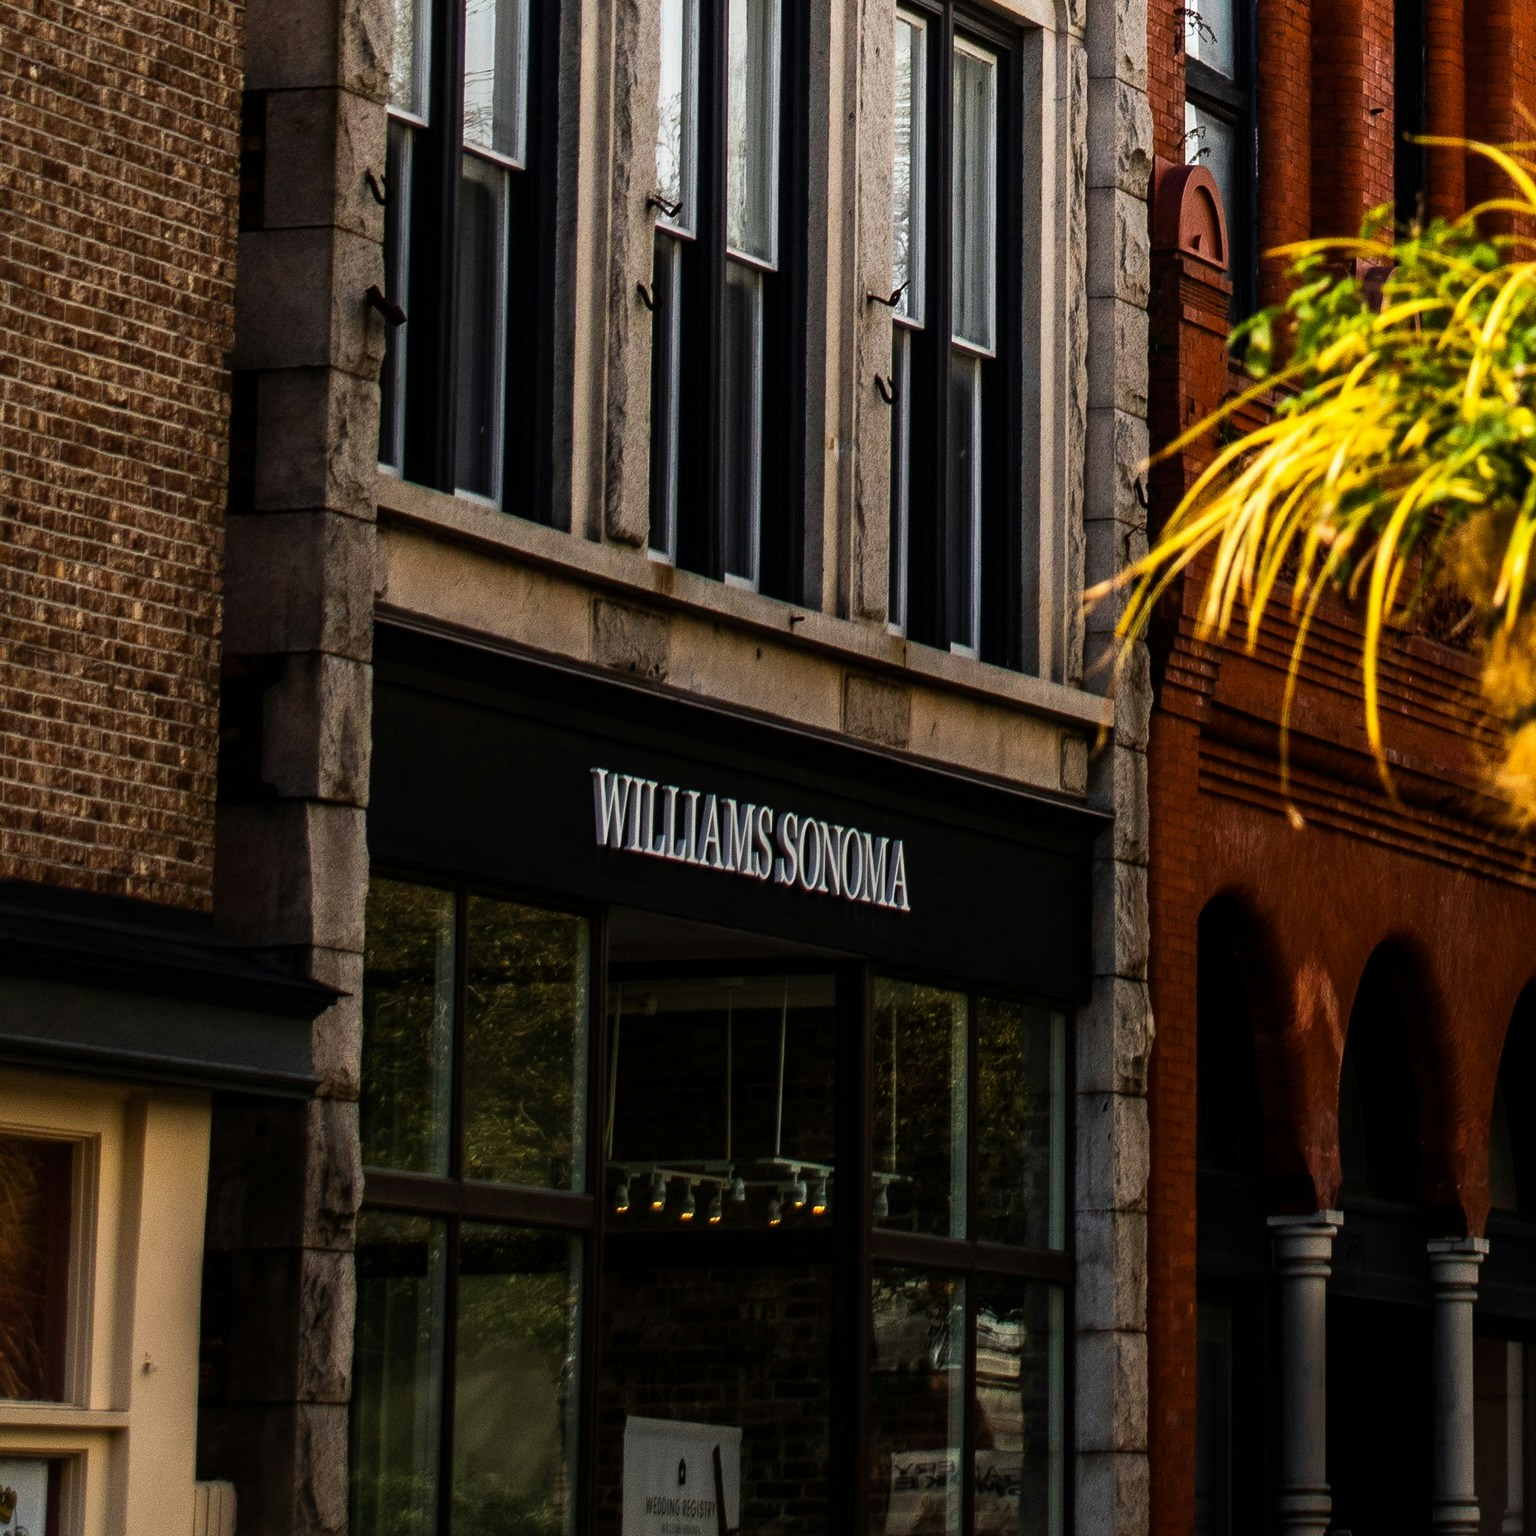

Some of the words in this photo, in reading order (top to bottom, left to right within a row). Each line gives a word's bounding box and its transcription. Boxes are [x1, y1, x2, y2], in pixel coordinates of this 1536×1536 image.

[589, 767, 774, 881] WILLIAMS
[773, 810, 912, 912] SONOMA
[645, 1495, 681, 1516] WEDDING
